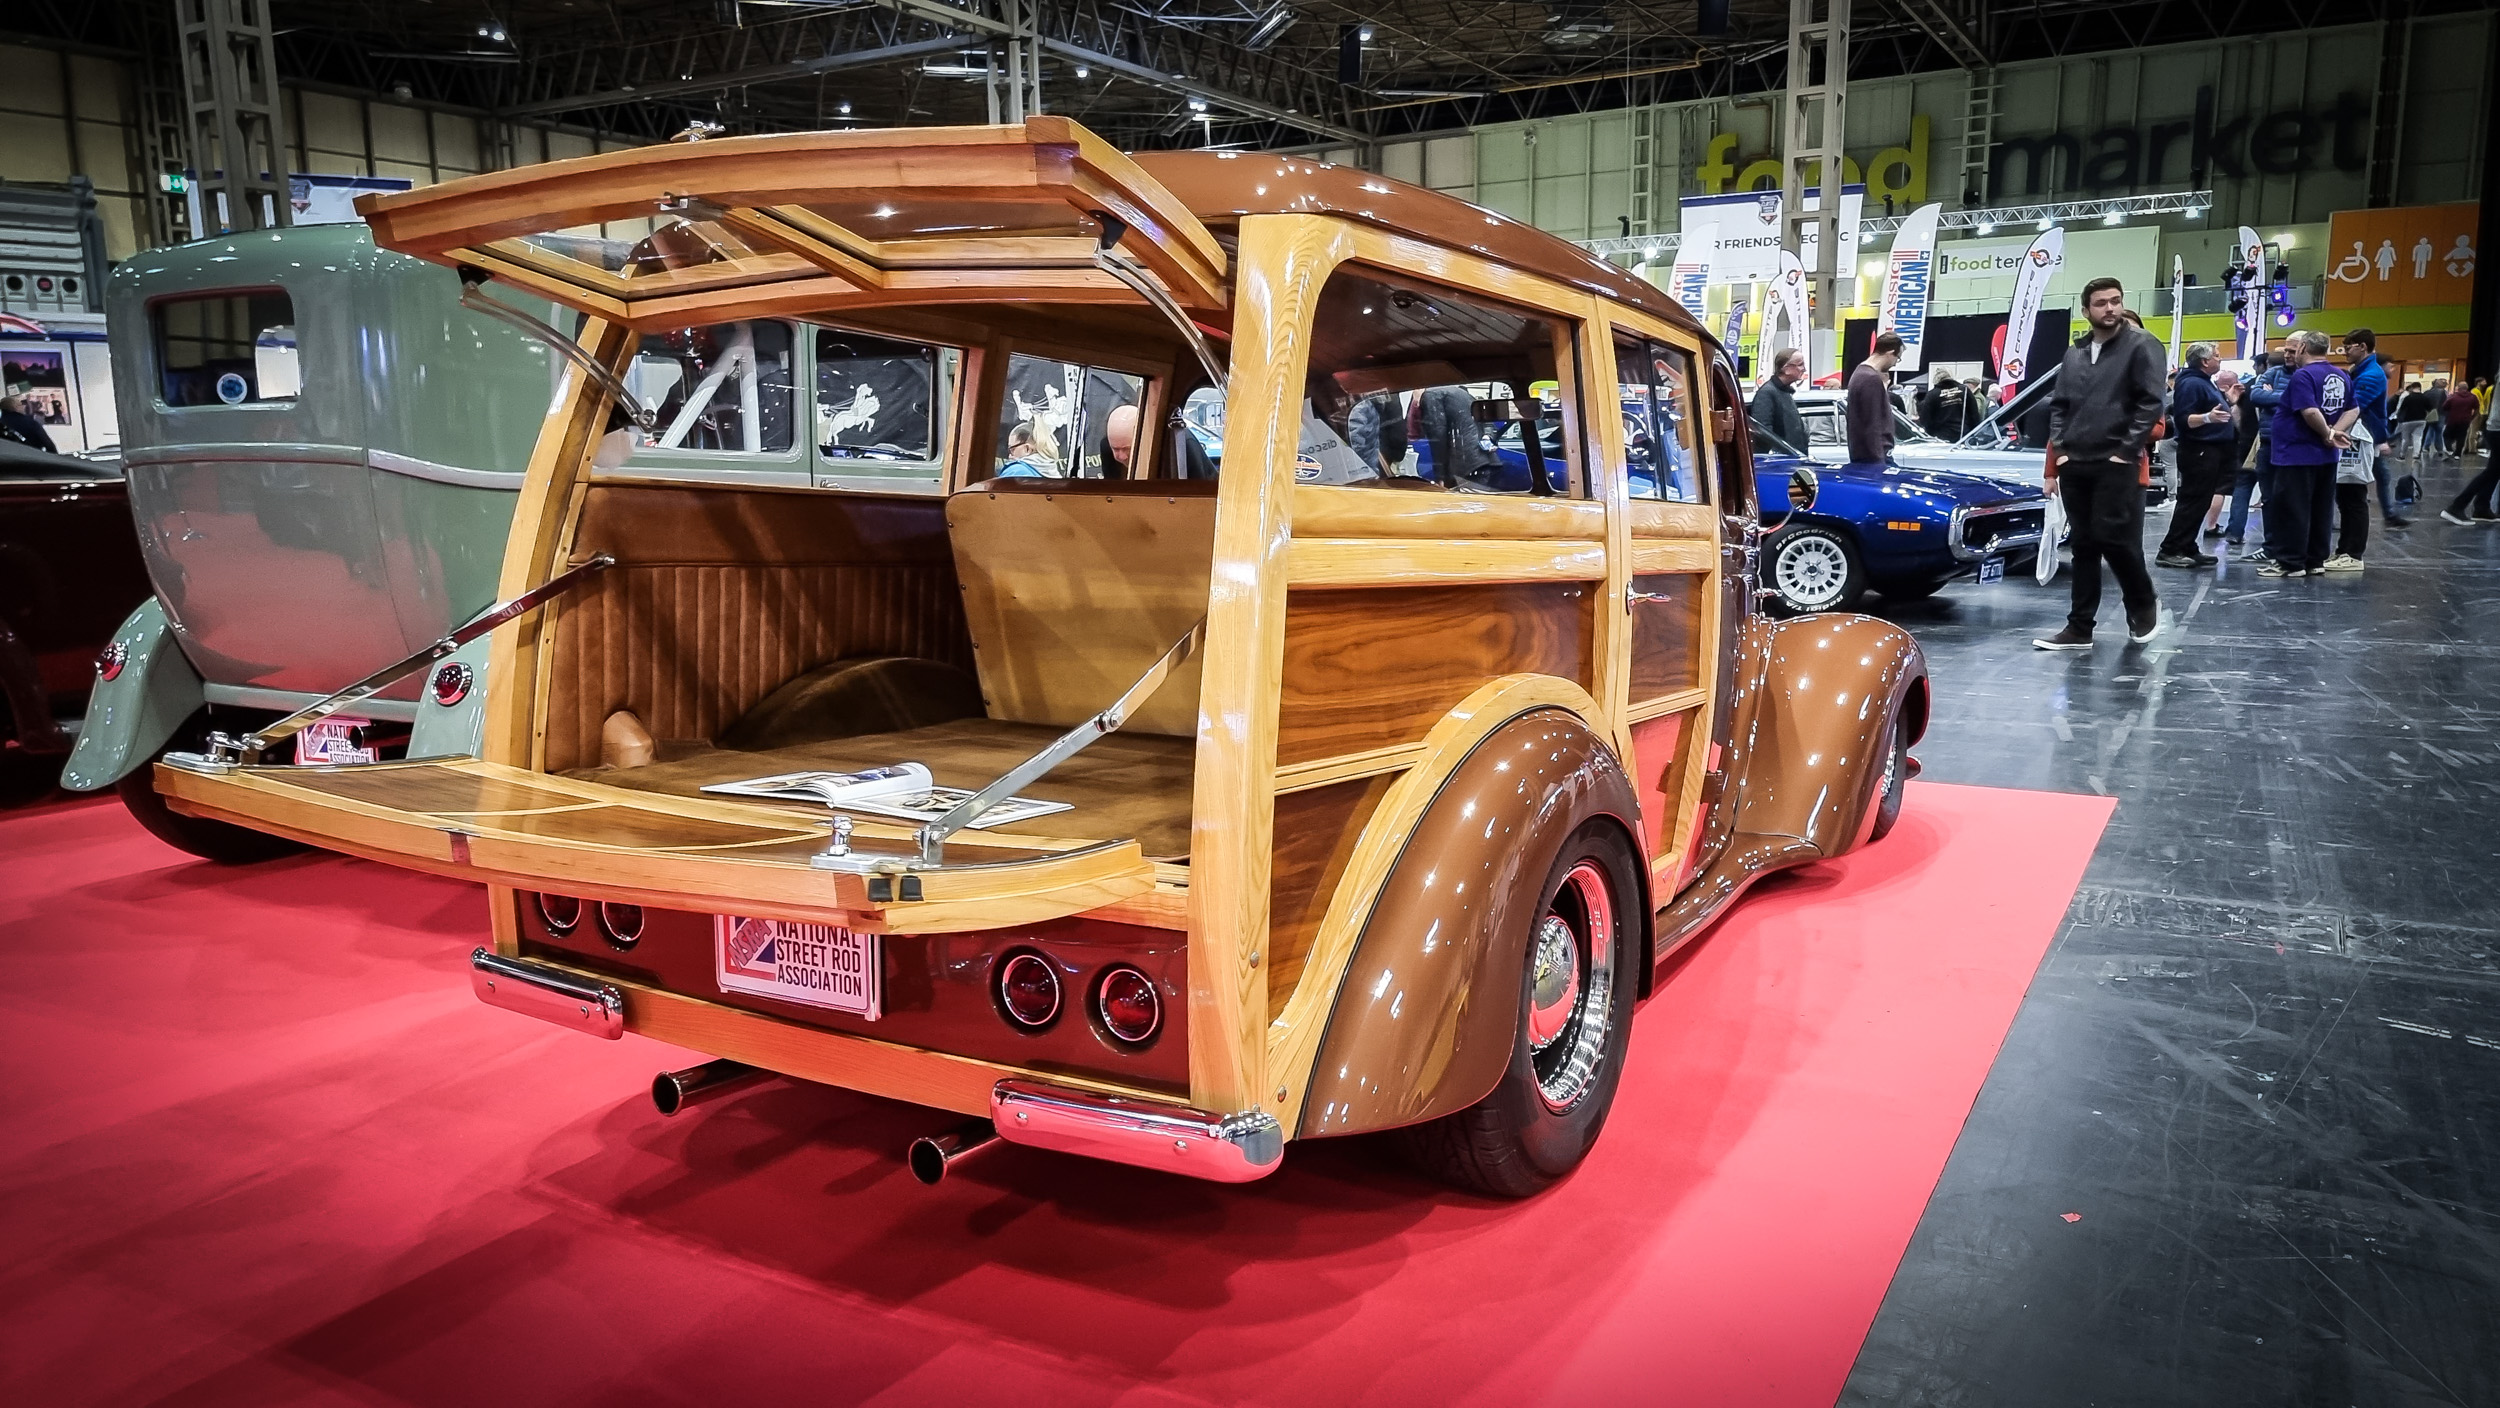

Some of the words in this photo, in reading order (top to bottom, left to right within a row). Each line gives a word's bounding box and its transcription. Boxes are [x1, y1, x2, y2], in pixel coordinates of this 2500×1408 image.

[1988, 84, 2372, 196] market
[1724, 236, 1781, 249] FRIENDS
[1950, 254, 1992, 272] food
[1885, 261, 1901, 331] LASSIC
[1894, 261, 1930, 346] AMERICAN
[1776, 528, 1842, 550] BFGoodrich
[776, 922, 861, 949] NATIONAL
[776, 938, 827, 968] STREET
[832, 949, 861, 974] ROD
[777, 963, 862, 997] ASSOCIATION
